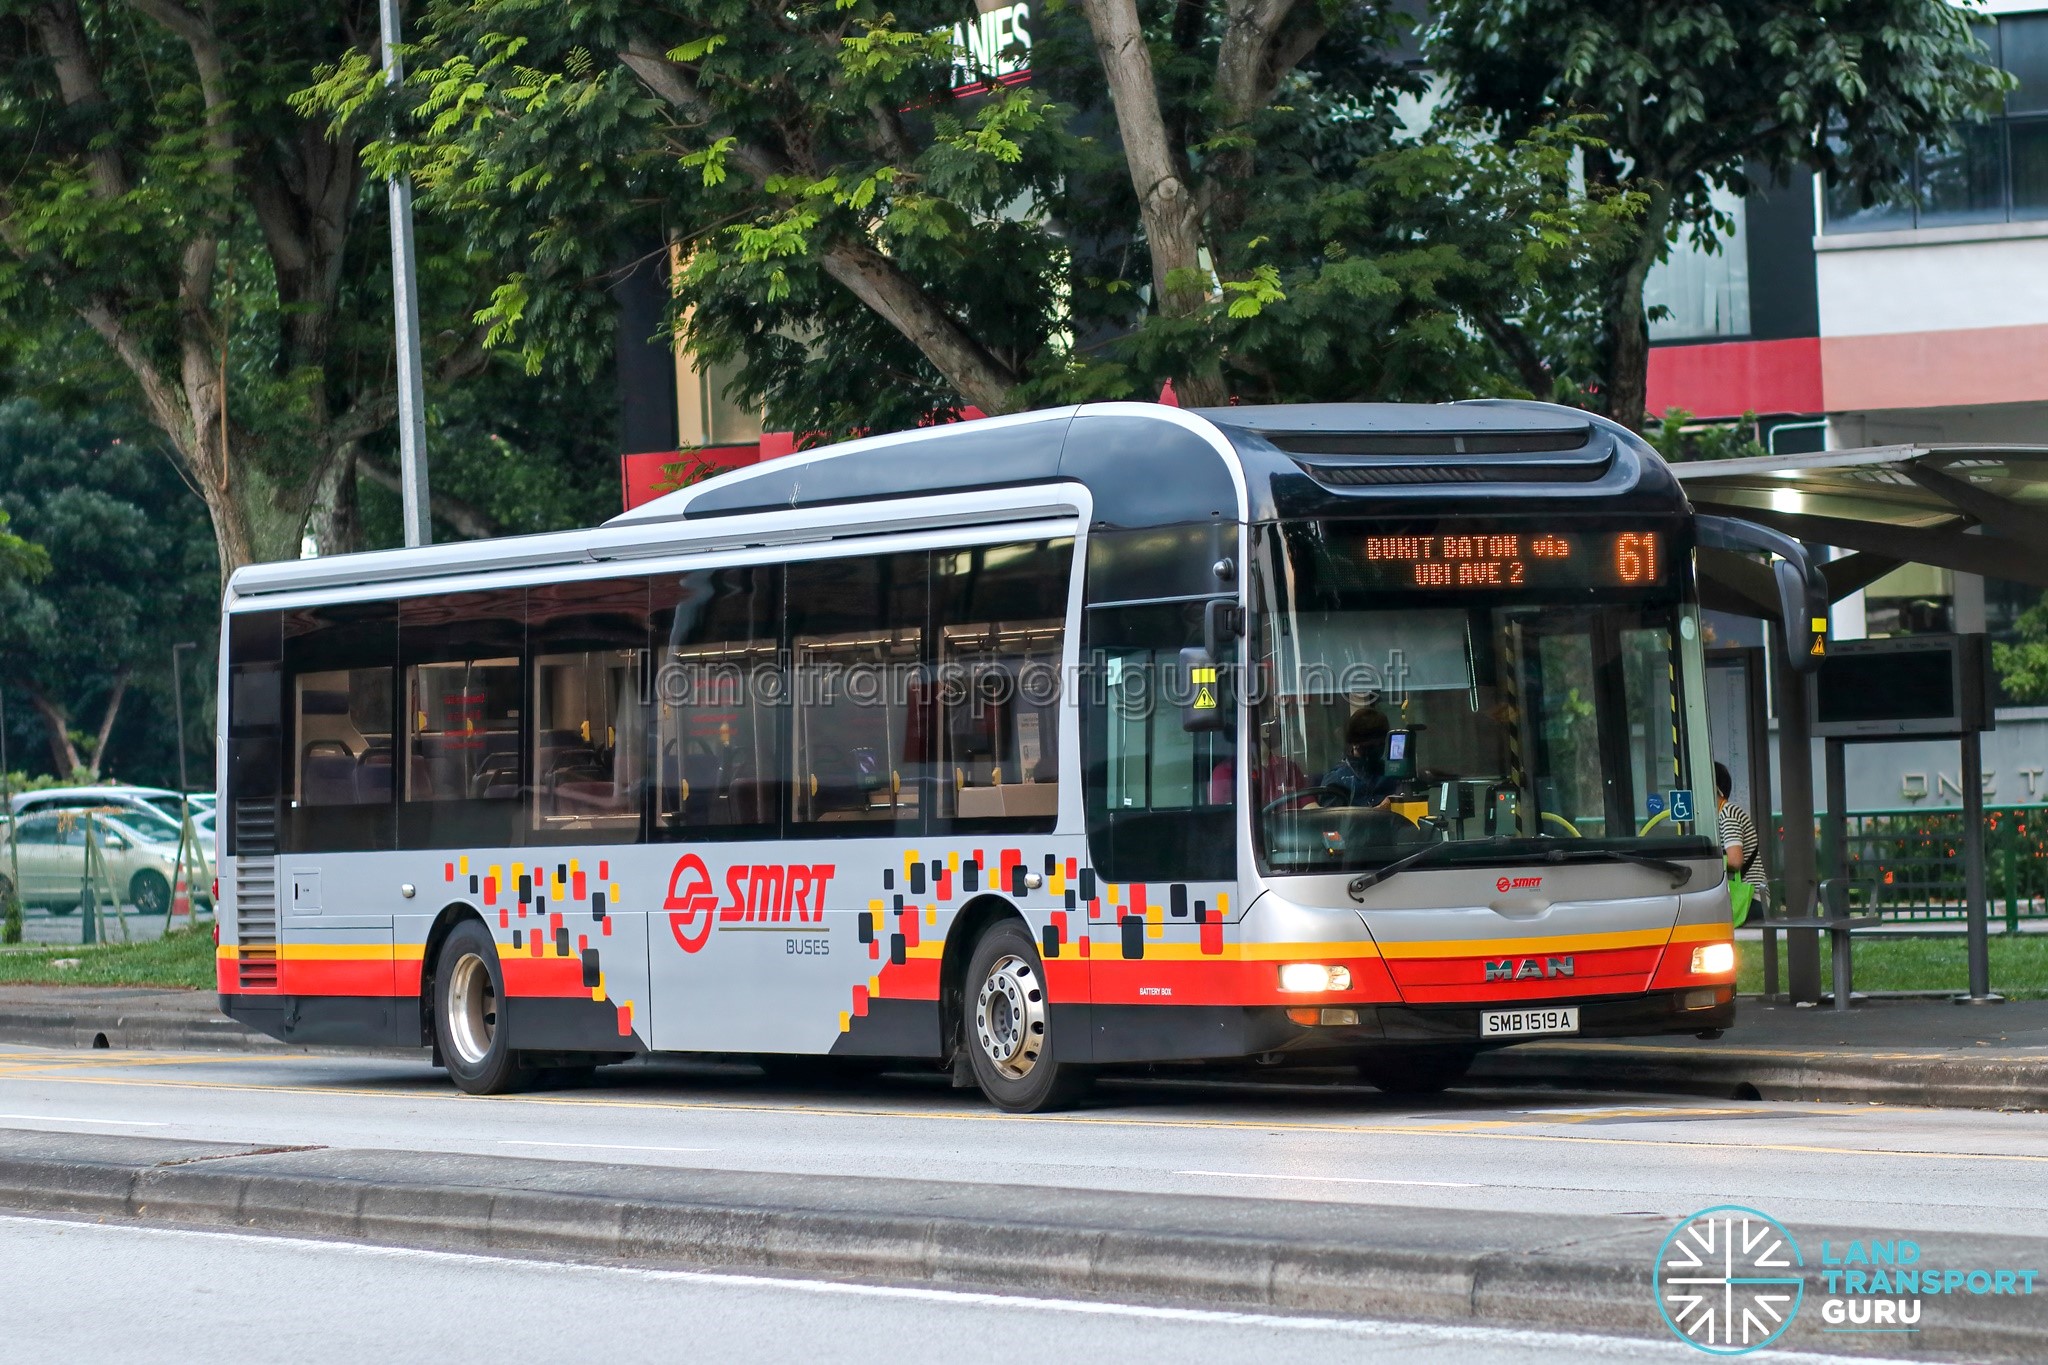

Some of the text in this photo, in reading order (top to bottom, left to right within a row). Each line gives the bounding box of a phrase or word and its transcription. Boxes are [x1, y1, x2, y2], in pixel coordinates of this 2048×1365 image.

[930, 2, 1031, 88] ANIES
[1367, 534, 1569, 560] BUKIT BATOK via
[1618, 532, 1656, 581] 61
[1415, 562, 1524, 585] UBI AVE 2
[719, 864, 836, 922] SMRT
[1511, 877, 1543, 888] SMRT
[786, 939, 830, 955] BUSES
[1485, 956, 1575, 983] MAN
[1139, 987, 1172, 996] BATTERY BOX
